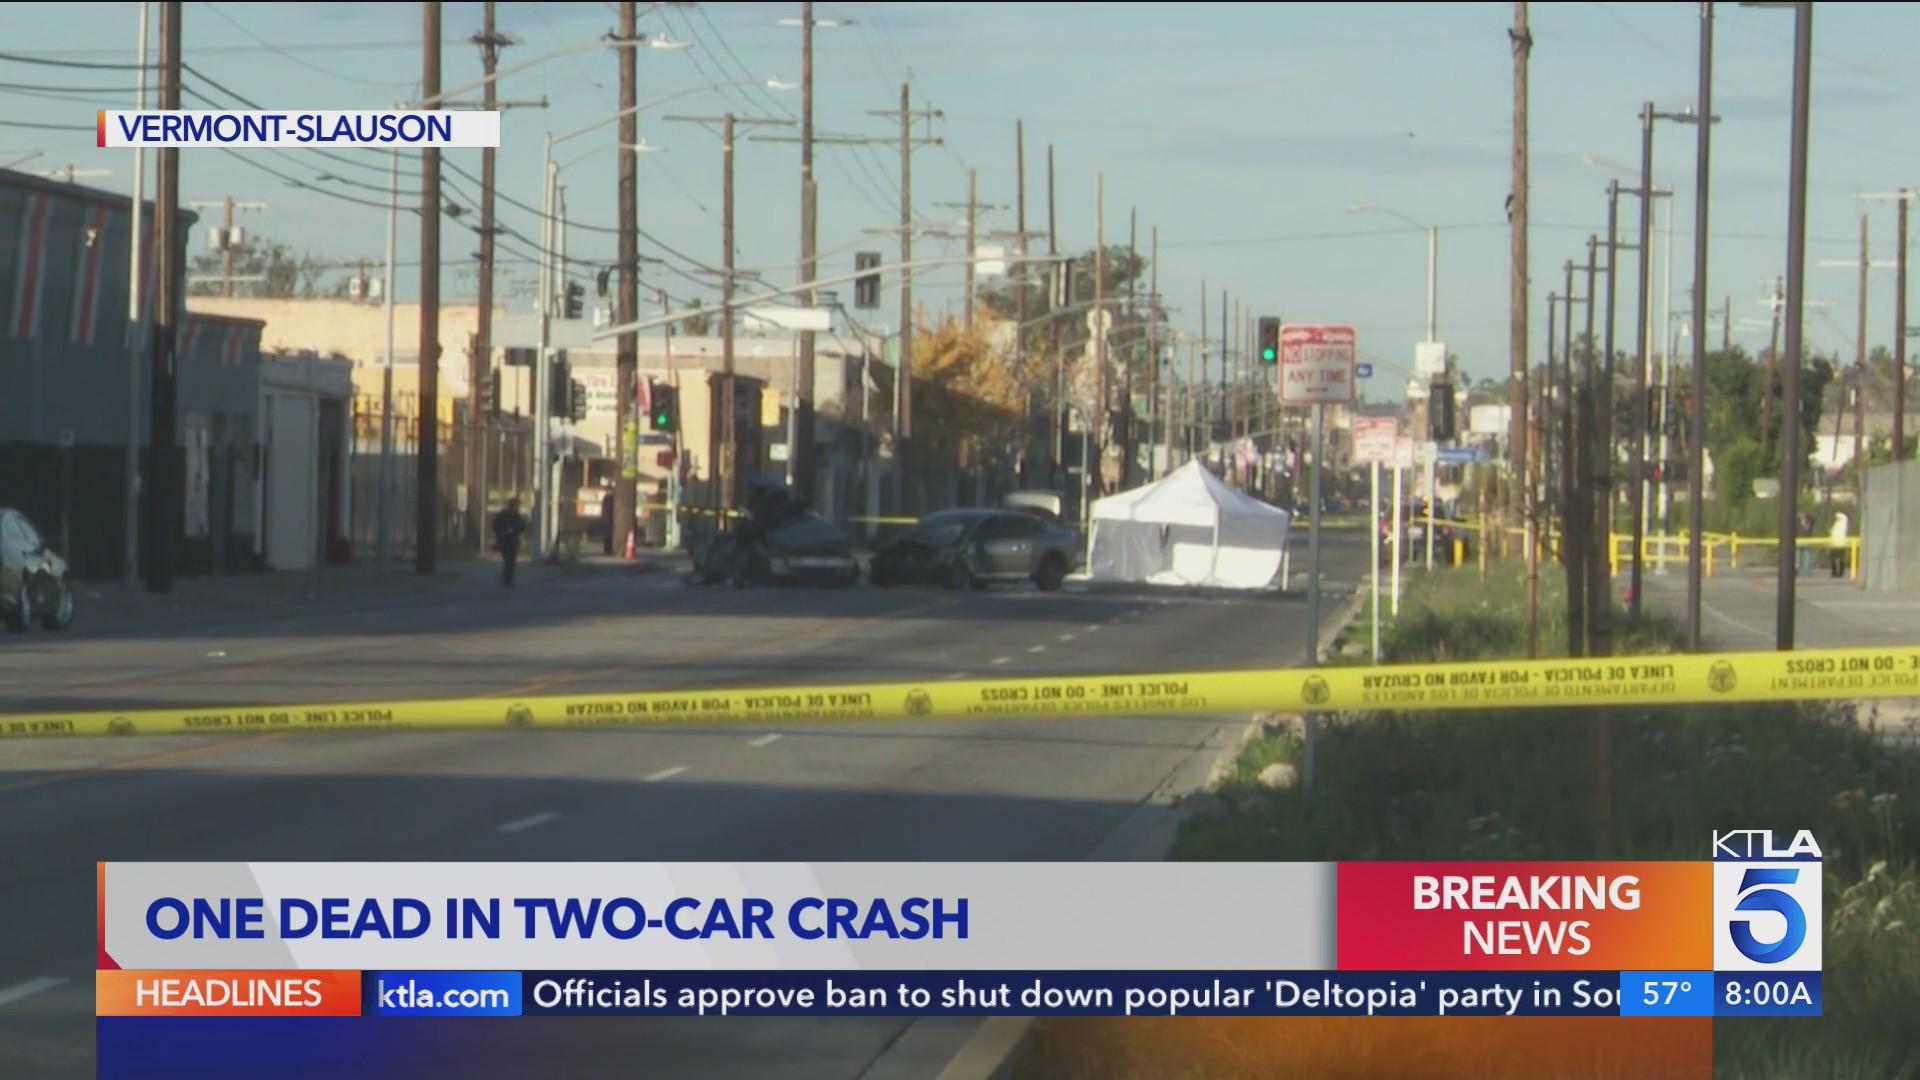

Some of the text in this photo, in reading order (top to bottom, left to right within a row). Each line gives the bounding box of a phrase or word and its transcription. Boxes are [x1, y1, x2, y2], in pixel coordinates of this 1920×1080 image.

[1288, 369, 1312, 382] ANY
[1319, 369, 1346, 383] TIME
[1786, 659, 1835, 674] CROSS
[1840, 657, 1869, 672] NOT
[1875, 656, 1894, 671] DO
[1450, 671, 1495, 686] FAVOR
[1500, 670, 1529, 684] POR
[1544, 668, 1601, 682] POLICIA
[1608, 666, 1625, 680] DE
[1630, 664, 1674, 680] LINEA
[1363, 674, 1421, 689] CRUZAR
[1425, 673, 1445, 686] NO
[1770, 673, 1918, 690] POLICE DEPARTMENT
[981, 688, 1028, 701] CROSS
[1034, 687, 1061, 700] NOT
[1066, 686, 1085, 698] DO
[1101, 684, 1133, 697] LINE
[1138, 682, 1188, 696] POLICE
[1430, 689, 1456, 701] LOS
[1544, 684, 1560, 697] DE
[1564, 682, 1675, 697] DEPARTAMENTO
[652, 700, 697, 712] FAVOR
[702, 698, 730, 711] POR
[744, 695, 801, 709] POLICIA
[807, 694, 824, 706] DE
[828, 693, 871, 707] LINEA
[565, 702, 623, 716] CRUZAR
[627, 701, 647, 713] NO
[183, 715, 231, 728] CROSS
[237, 714, 265, 726] NOT
[269, 713, 289, 724] DO
[303, 712, 337, 723] LINE
[341, 710, 393, 722] POLICE
